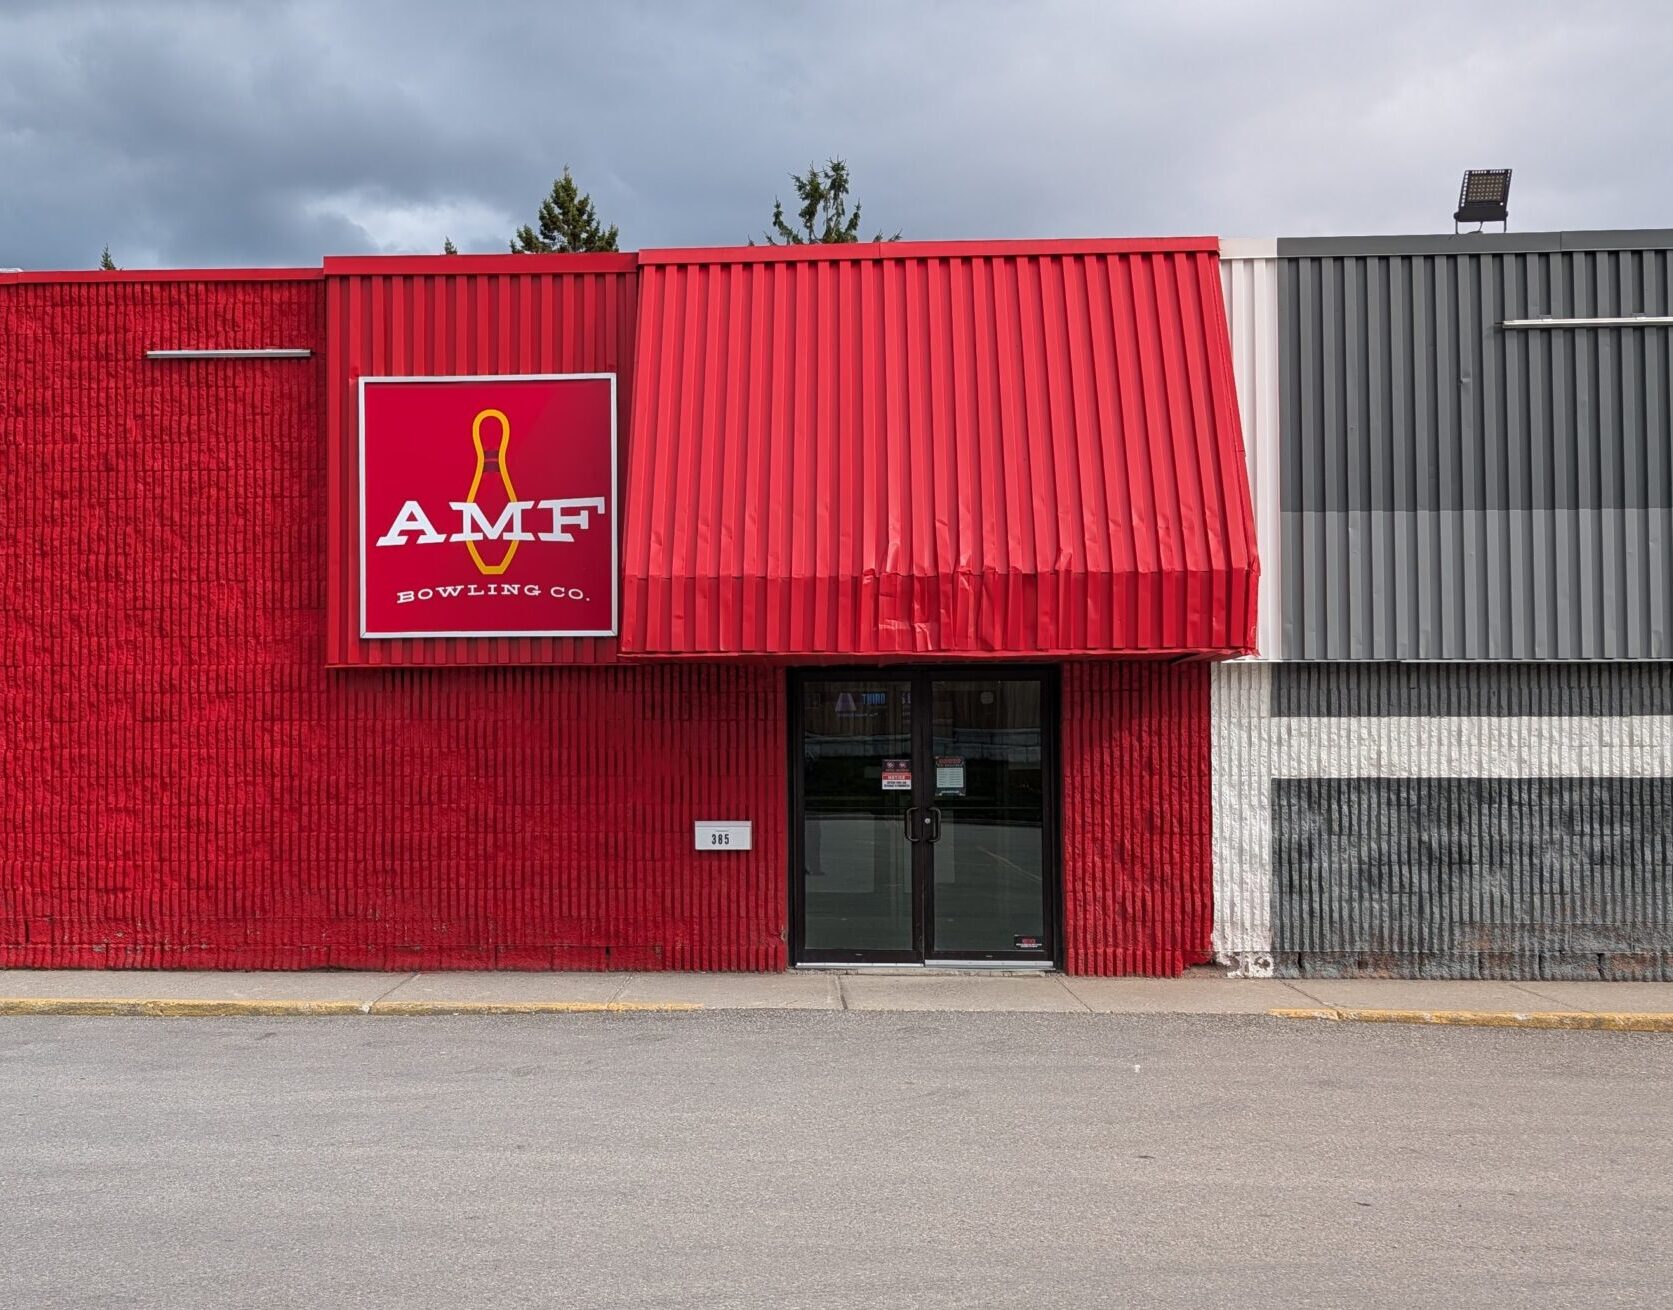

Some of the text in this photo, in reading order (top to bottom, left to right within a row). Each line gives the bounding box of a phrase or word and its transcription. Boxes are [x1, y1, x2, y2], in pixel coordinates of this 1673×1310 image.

[375, 496, 606, 547] AMF
[396, 584, 591, 604] BOWLING CO.
[711, 833, 730, 845] 385
